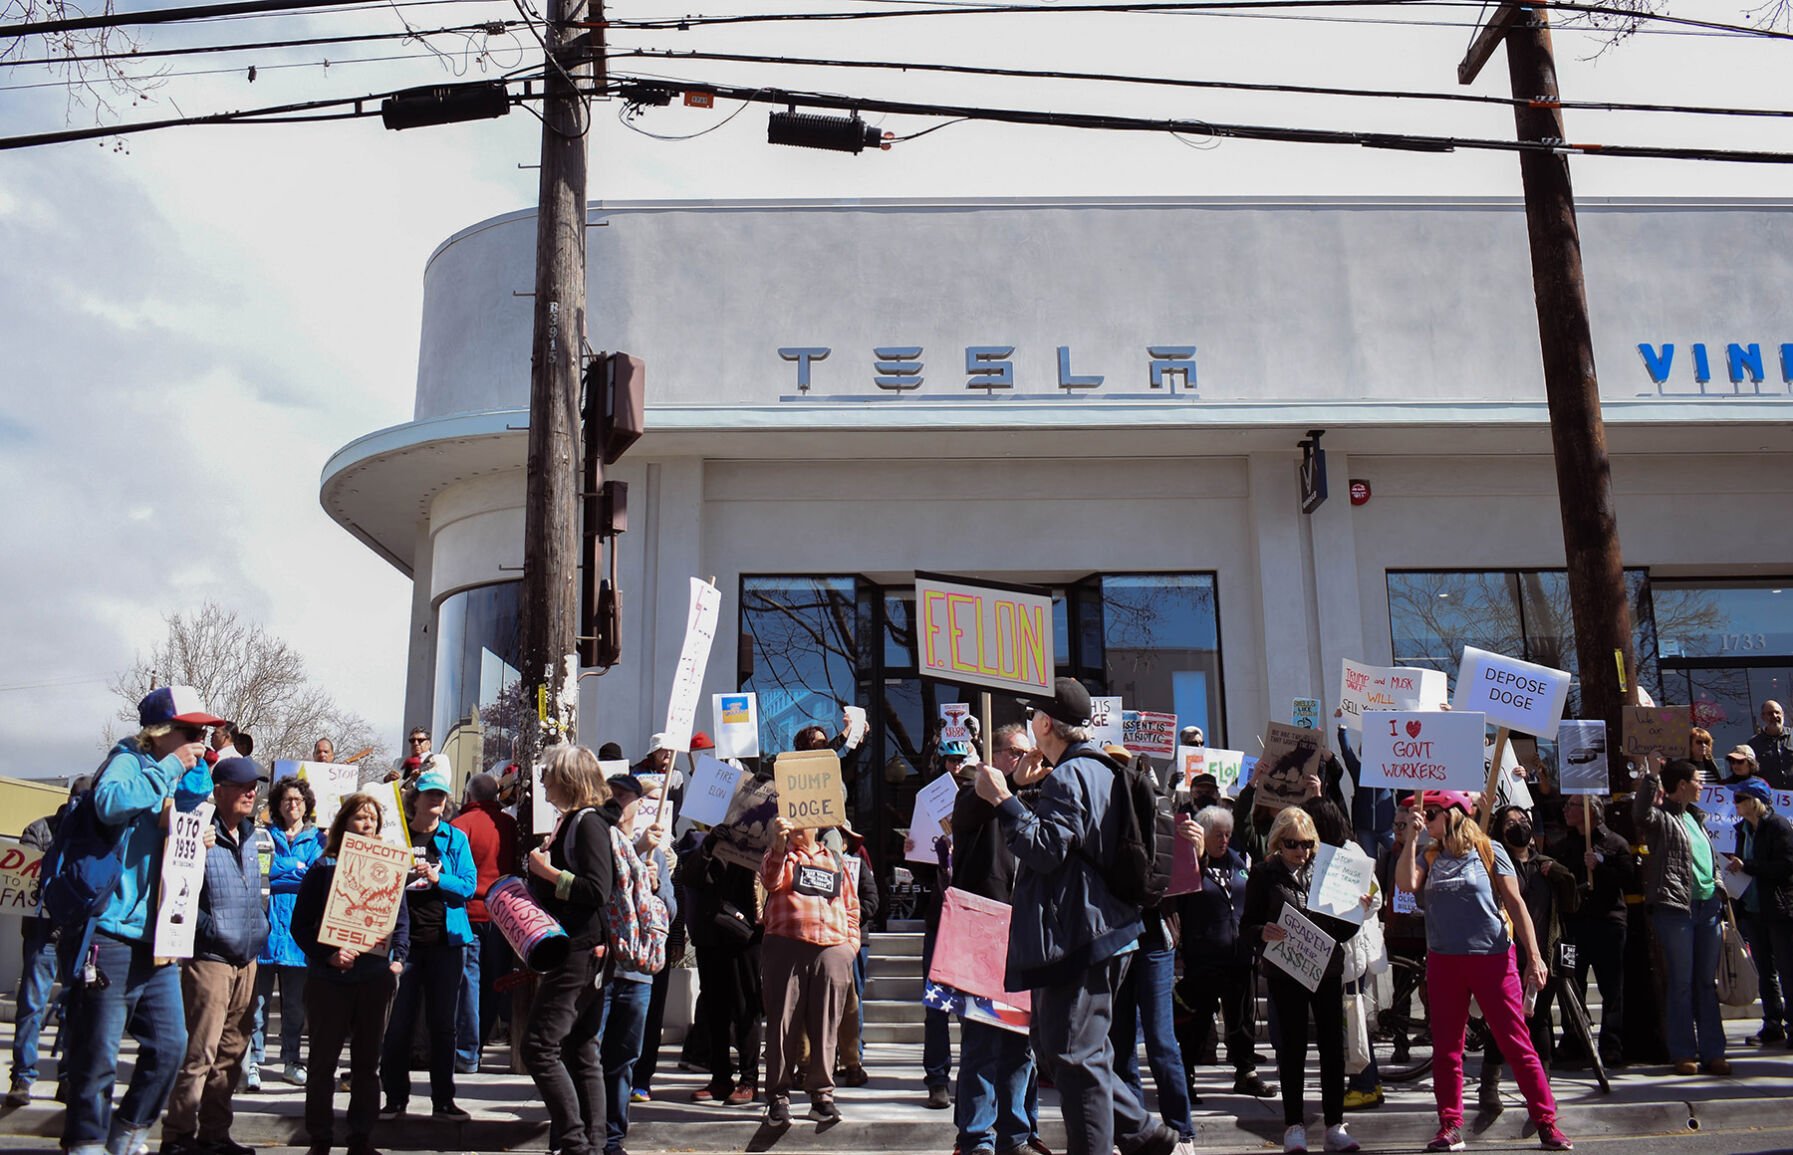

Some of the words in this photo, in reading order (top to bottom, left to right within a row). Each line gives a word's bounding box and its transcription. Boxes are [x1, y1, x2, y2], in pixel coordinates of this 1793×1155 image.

[778, 346, 1197, 389] TESLA
[1720, 633, 1766, 650] 1733
[1346, 668, 1370, 681] TRUMP
[1390, 677, 1413, 690] MUSK
[1485, 667, 1547, 695] DEPOSE
[1091, 700, 1111, 713] HIS
[1341, 698, 1360, 716] SELL
[1367, 692, 1395, 705] WILL
[1489, 687, 1533, 710] DOGE
[1091, 714, 1109, 727] GE
[1123, 720, 1153, 732] ISSENT
[1389, 720, 1398, 737] I
[1123, 733, 1165, 744] ATRIOTIC
[1392, 741, 1434, 759] GOVT
[328, 768, 358, 781] STOP
[716, 768, 734, 783] FIRE
[1382, 763, 1447, 781] WORKERS
[787, 772, 831, 791] DUMP
[708, 785, 726, 799] ELON
[789, 799, 833, 818] DOGE
[174, 837, 197, 860] 1939
[345, 838, 408, 861] BOYCOTT
[3, 874, 21, 887] TO
[889, 884, 932, 893] TESL
[493, 900, 526, 943] SUCKS
[326, 925, 387, 950] TESLA
